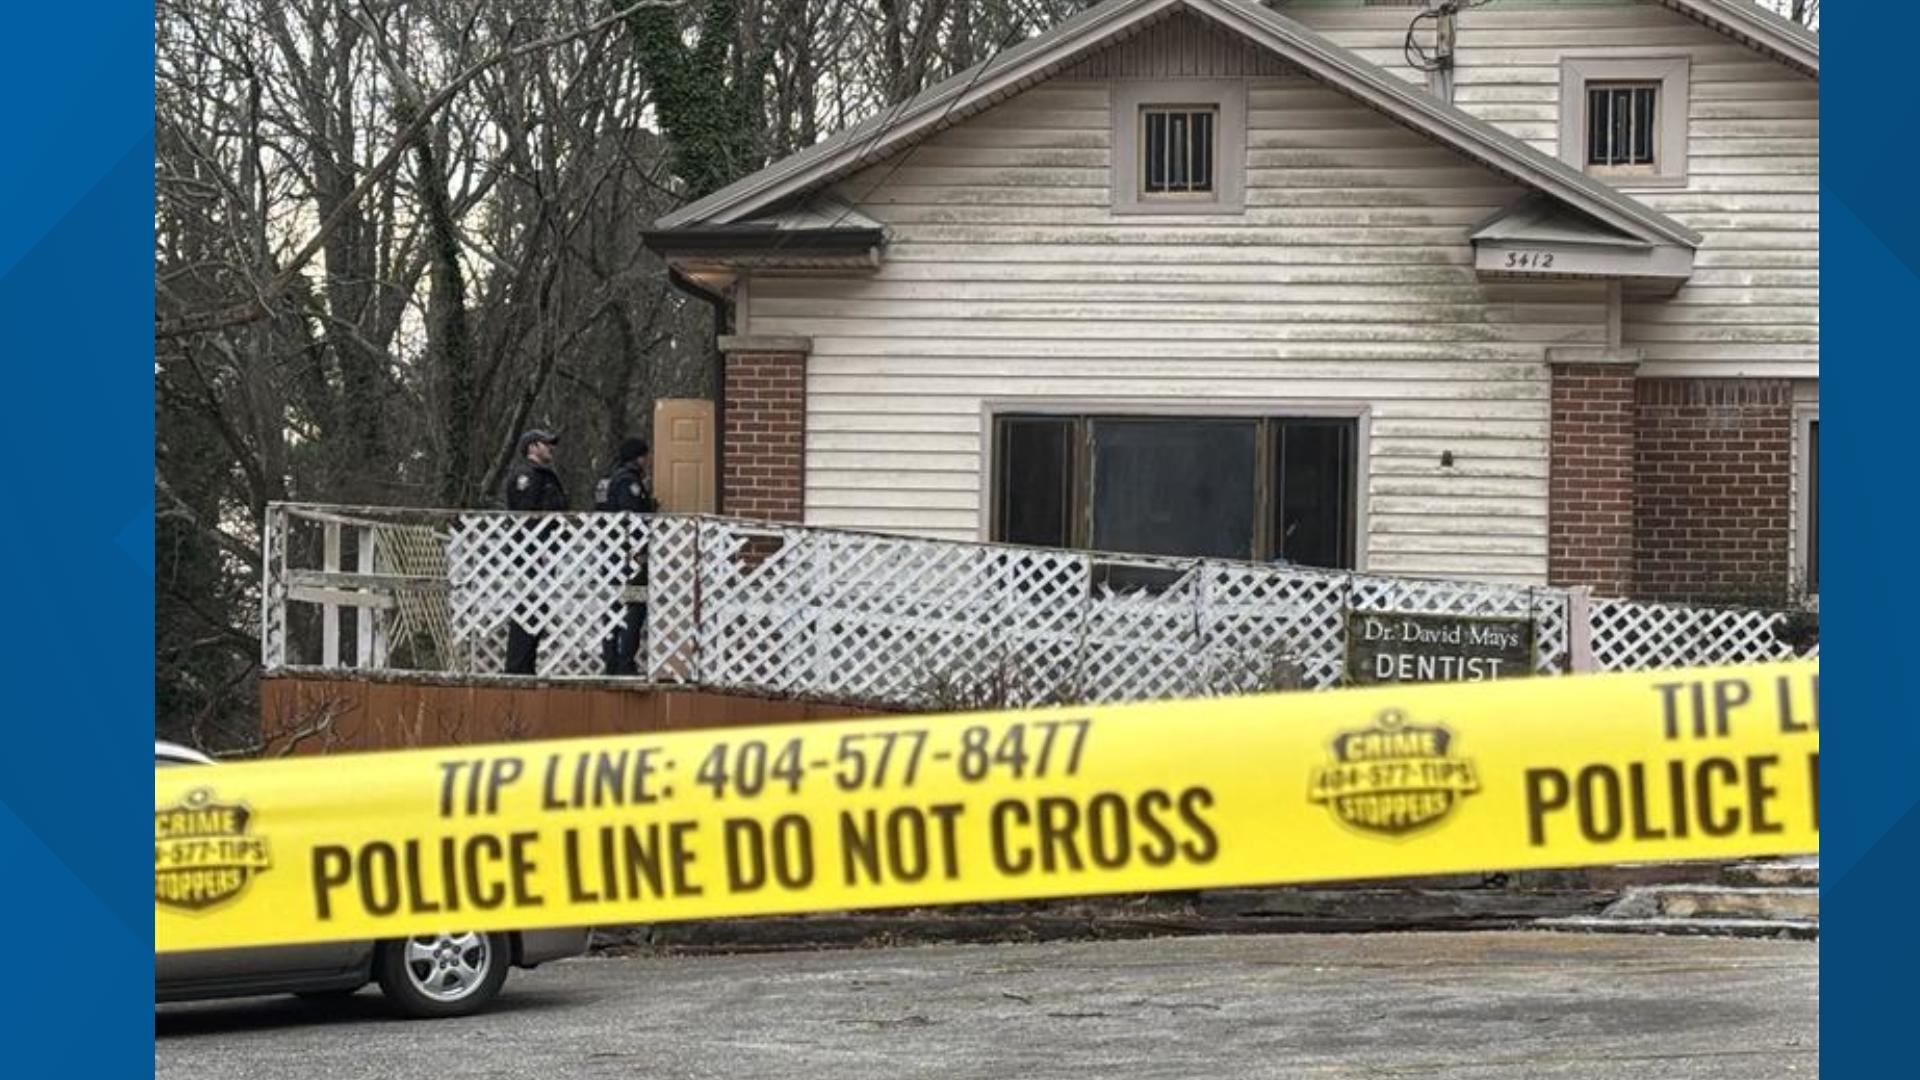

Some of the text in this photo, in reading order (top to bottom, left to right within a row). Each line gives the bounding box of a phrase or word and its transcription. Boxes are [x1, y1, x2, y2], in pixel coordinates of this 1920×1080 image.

[1504, 251, 1554, 268] 3412
[1363, 618, 1519, 650] Dr. David Mays
[1375, 653, 1504, 682] DENTIST
[1652, 678, 1752, 740] TIP
[1345, 730, 1436, 760] CRIME
[437, 718, 1093, 819] TIP LINE: 404-577-8477
[1339, 790, 1448, 827] STOPPERS
[1524, 754, 1784, 848] POLICE
[155, 810, 238, 838] CRIME
[310, 785, 1220, 921] POLICE LINE DO NOT CROSS
